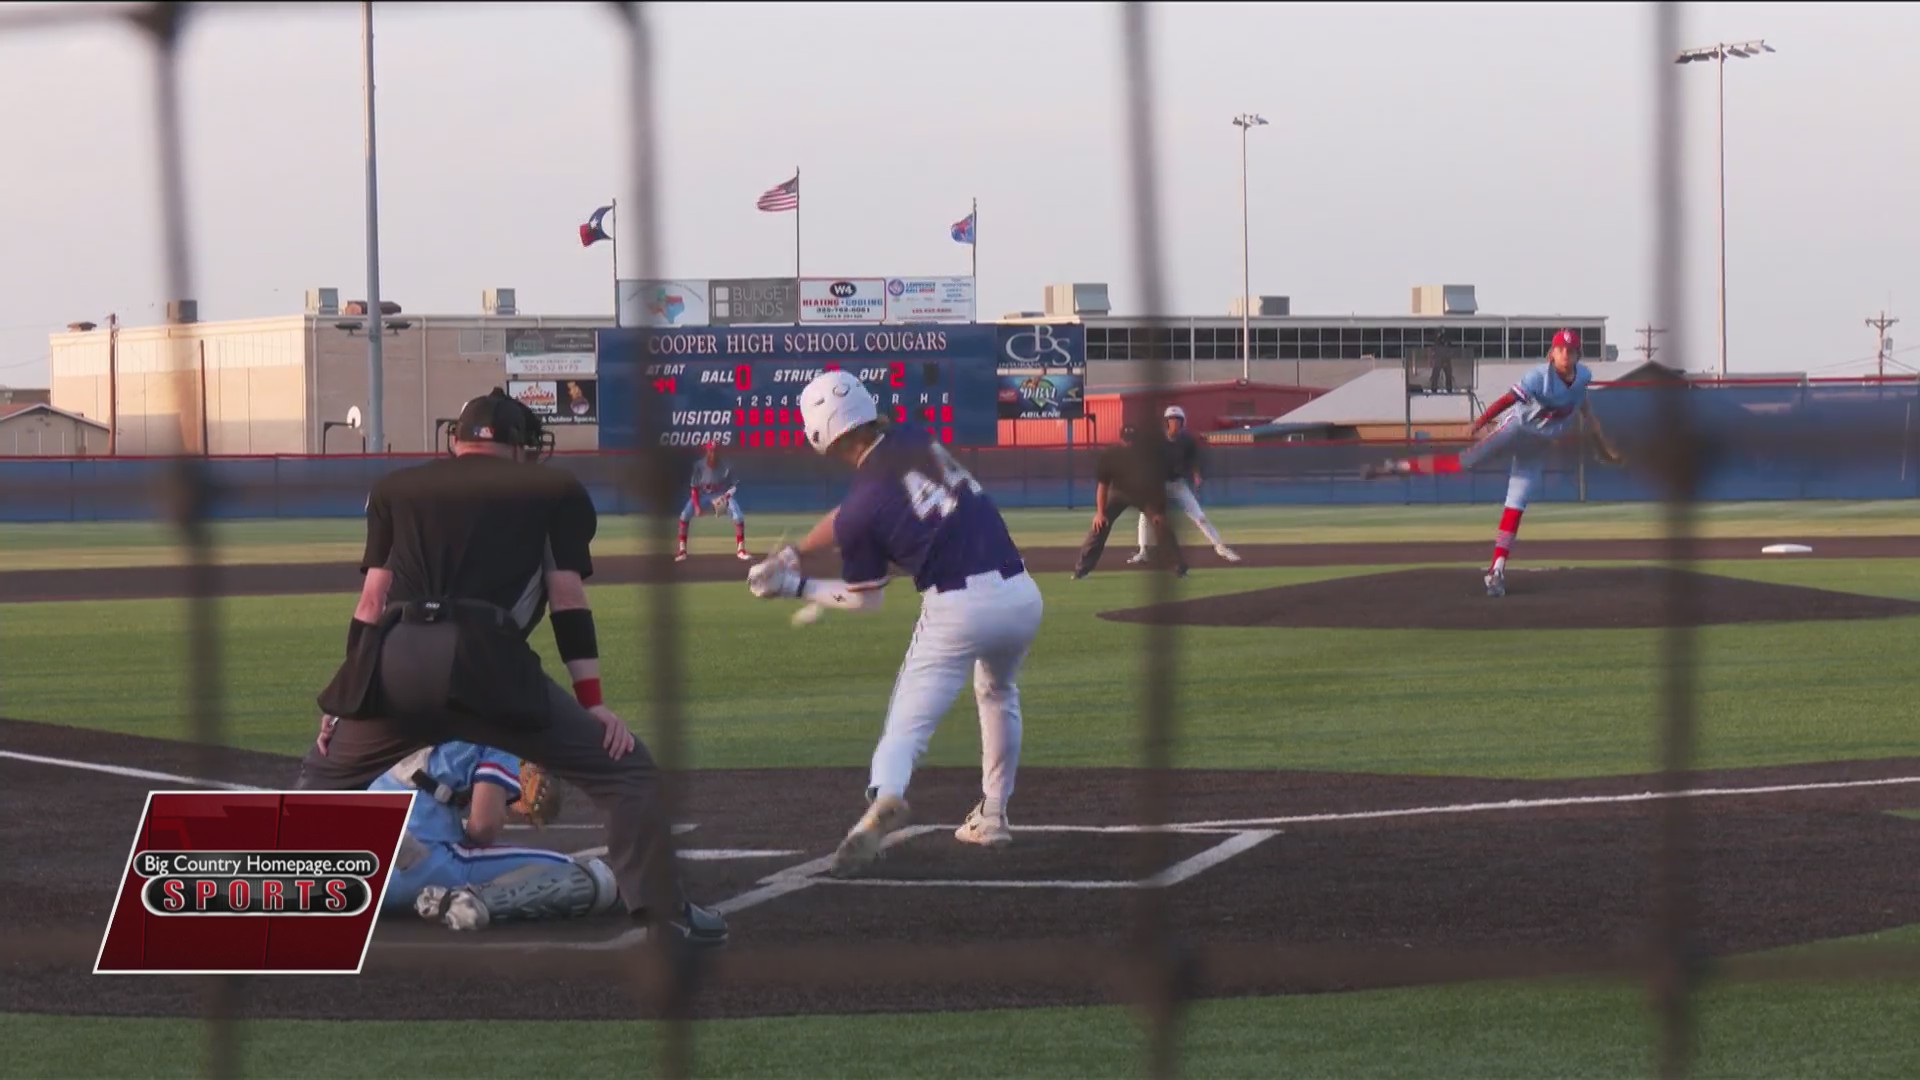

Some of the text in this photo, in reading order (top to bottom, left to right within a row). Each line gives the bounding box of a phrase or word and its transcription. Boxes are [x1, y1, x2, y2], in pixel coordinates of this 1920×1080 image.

[733, 286, 791, 301] BUDGET
[834, 284, 853, 295] W4
[733, 302, 784, 317] BLINDS
[803, 298, 883, 306] HEATING COOLING
[649, 331, 947, 354] COOPER HIGH SCHOOL COUGARS
[1006, 325, 1071, 366] CBS
[646, 363, 686, 376] AT BAT
[860, 361, 905, 387] OUT 2
[701, 364, 751, 391] BALL 0
[736, 395, 742, 407] 1
[751, 395, 759, 407] 2
[765, 395, 772, 407] 3
[781, 395, 788, 406] 4
[892, 393, 900, 404] R
[920, 393, 928, 403] H
[942, 393, 949, 403] E
[548, 415, 573, 423] Outdoor
[574, 416, 596, 424] Spaces
[672, 410, 732, 425] VISITOR
[1020, 410, 1061, 418] ABILENE
[660, 431, 732, 447] COUGARS
[903, 441, 983, 522] 44
